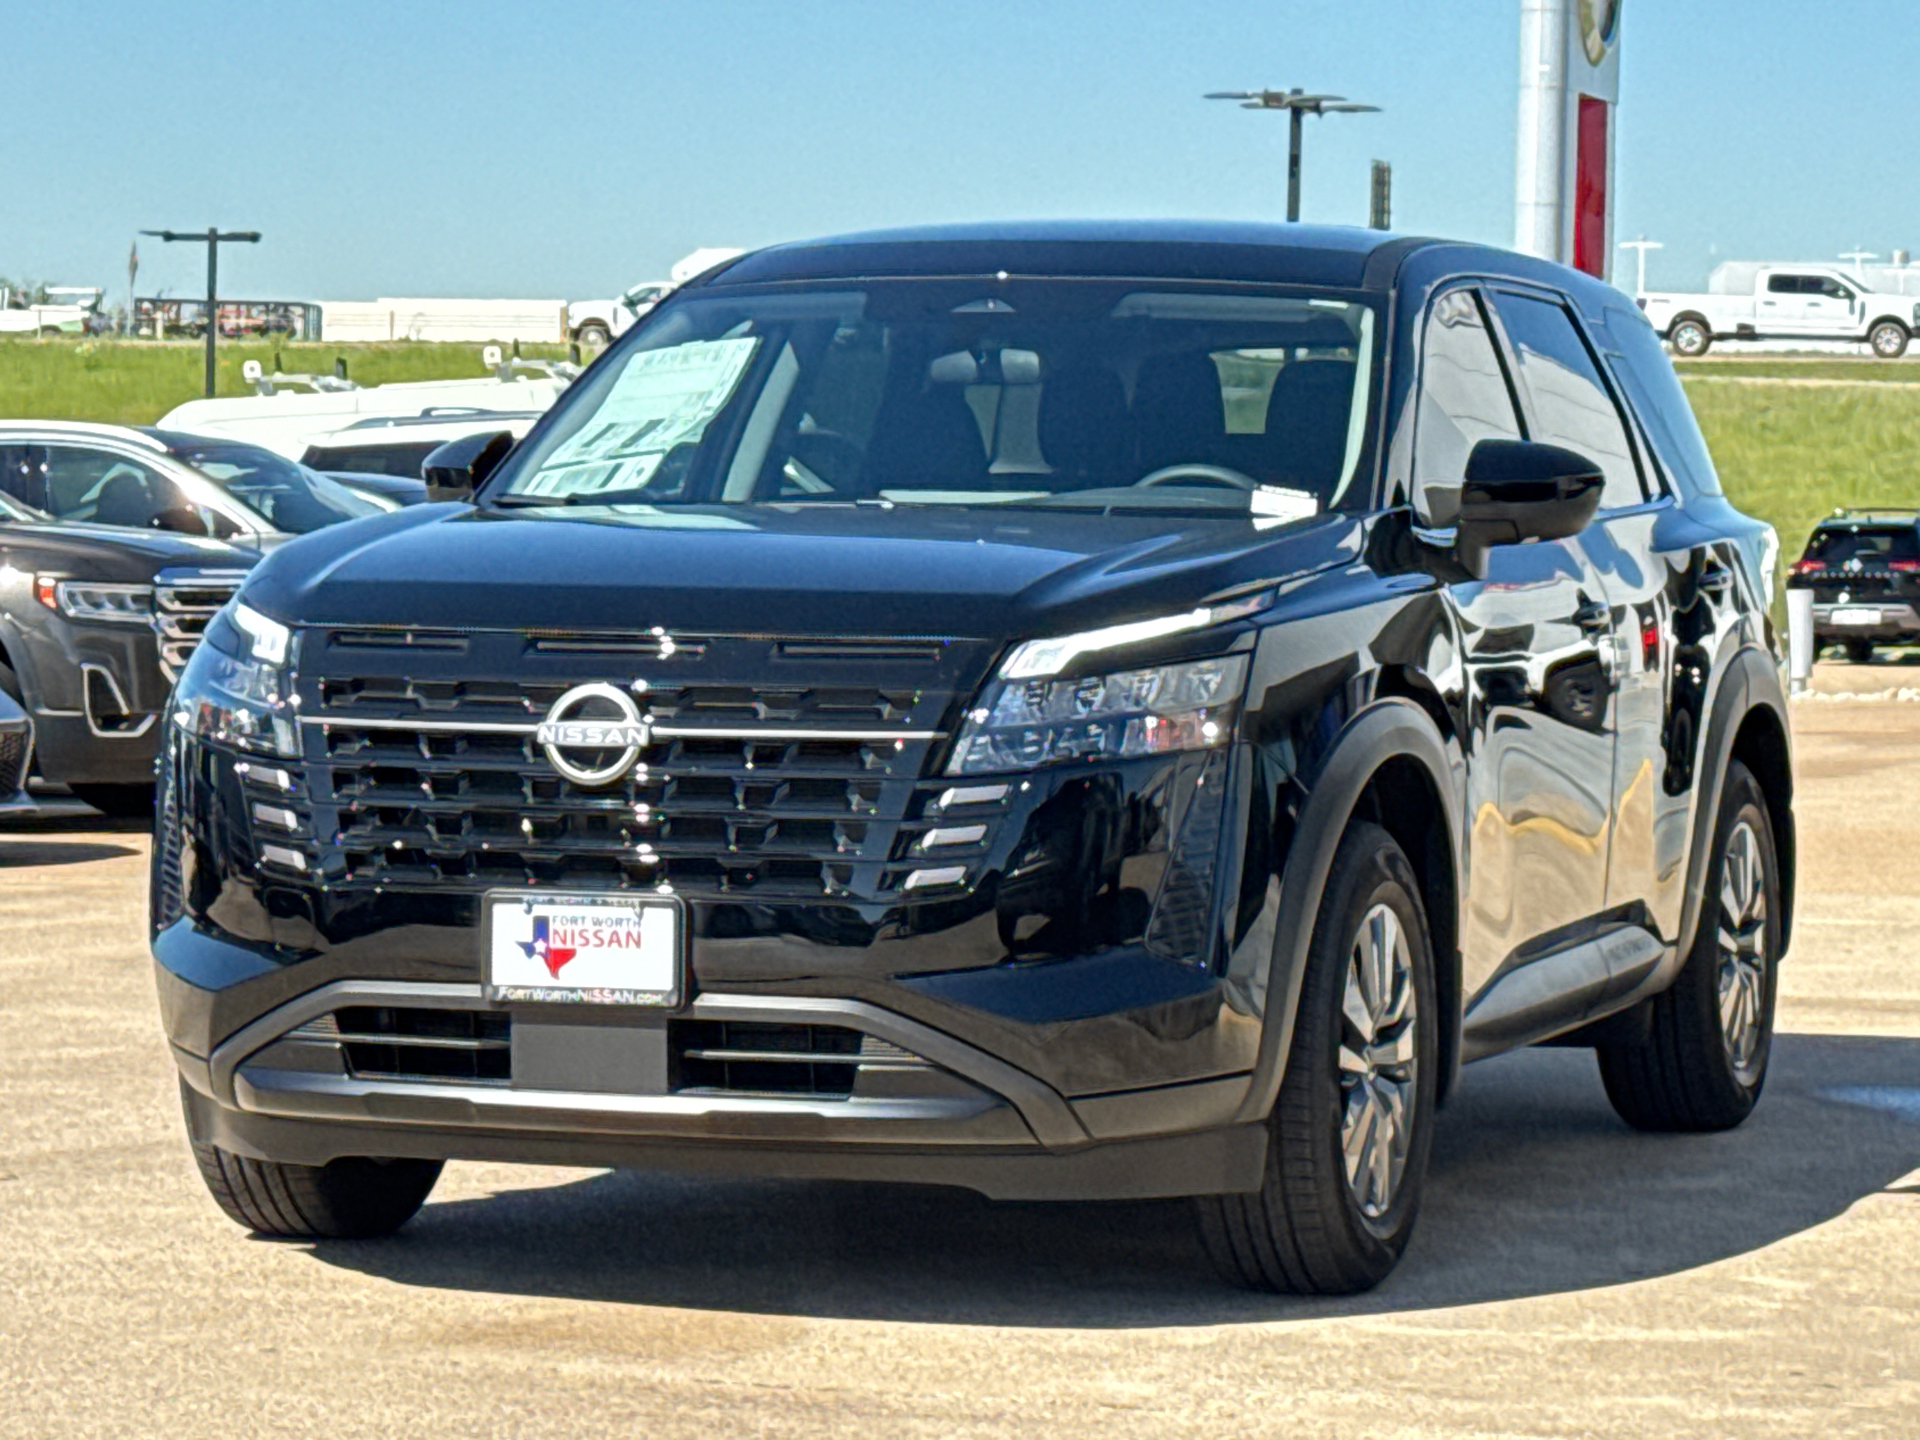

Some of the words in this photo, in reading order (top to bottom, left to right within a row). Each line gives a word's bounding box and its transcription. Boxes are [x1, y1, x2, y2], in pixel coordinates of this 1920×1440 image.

[539, 725, 646, 744] NISSAN
[552, 915, 587, 927] FORT
[591, 916, 642, 928] WORTH
[552, 928, 642, 949] NISSAN
